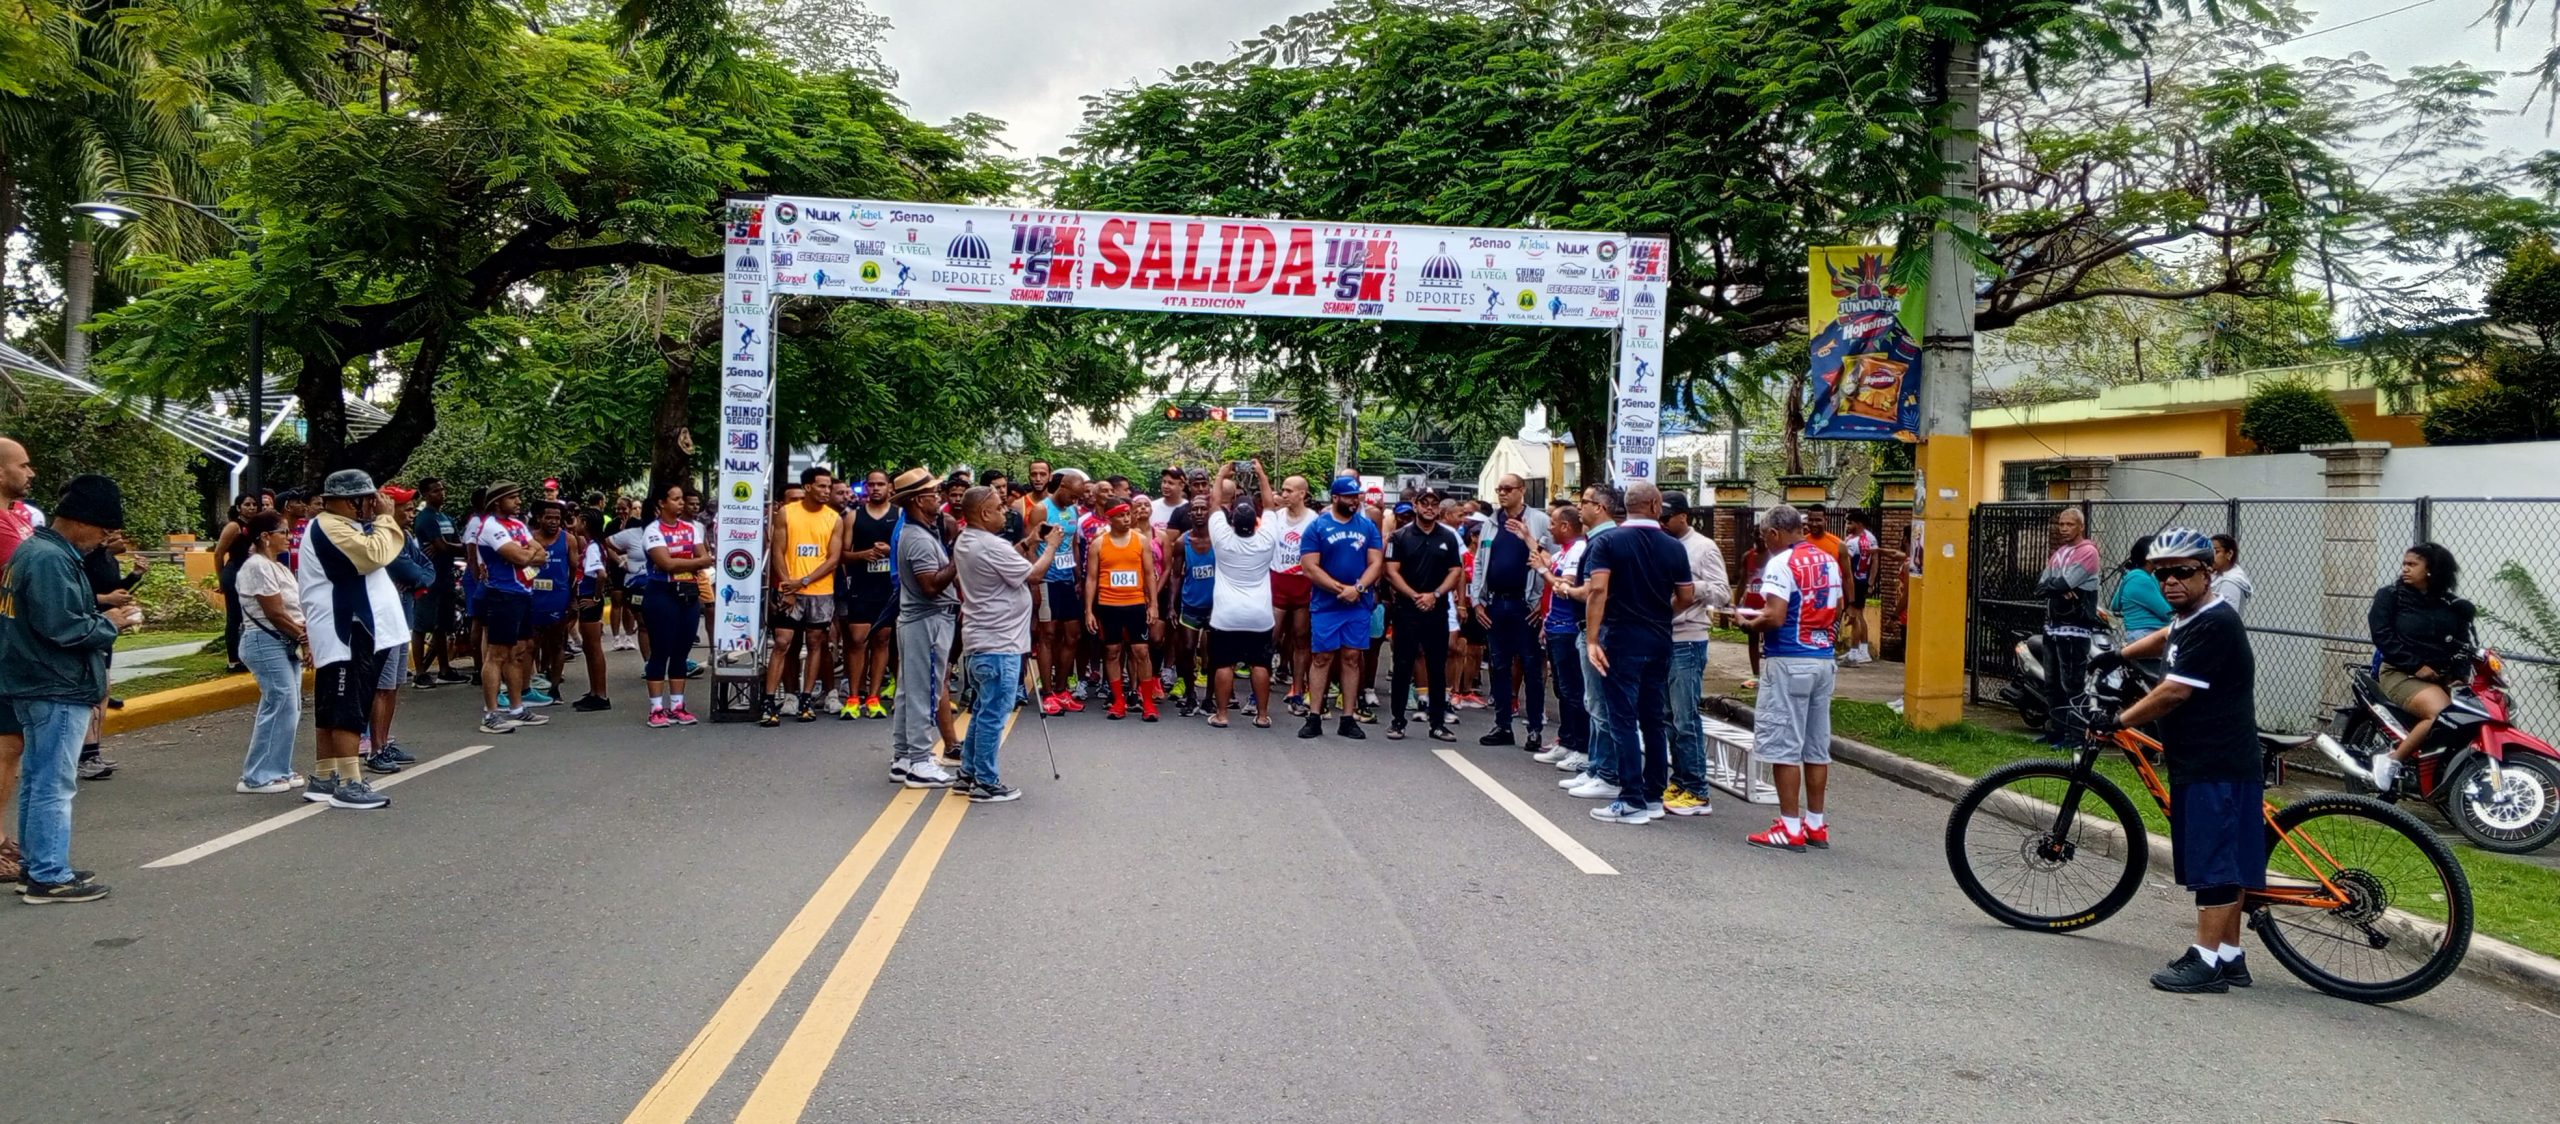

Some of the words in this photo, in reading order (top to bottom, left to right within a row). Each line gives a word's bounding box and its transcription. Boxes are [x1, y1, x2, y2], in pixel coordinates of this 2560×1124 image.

[894, 210, 934, 224] Genao
[1473, 237, 1511, 249] Genao
[893, 245, 908, 254] LA
[909, 246, 932, 255] VEGA
[1091, 218, 1317, 296] SALIDA
[728, 273, 768, 281] DEPORTES
[932, 270, 1005, 287] DEPORTES
[1471, 271, 1482, 280] LA
[1485, 271, 1507, 280] VEGA
[1010, 288, 1045, 302] SEMANA
[1046, 290, 1074, 303] SANTA
[1406, 291, 1476, 305] DEPORTES
[1162, 297, 1188, 307] 4TA
[1191, 296, 1246, 309] EDICIÓN
[1322, 301, 1356, 314] SEMANA
[1357, 303, 1384, 316] SANTA
[1838, 299, 1901, 315] JUNTADERA
[728, 305, 740, 315] LA
[741, 306, 765, 316] VEGA
[1627, 308, 1662, 316] DEPORTES
[1626, 340, 1638, 348] LA
[1639, 341, 1658, 349] VEGA
[730, 367, 764, 377] Genao
[729, 391, 762, 399] PREMIUM
[1626, 399, 1655, 409] Genao
[724, 405, 764, 418] CHINGO
[726, 416, 762, 426] REGIDOR
[1624, 421, 1653, 429] PREMIUM
[1618, 435, 1655, 447] CHINGO
[1620, 445, 1652, 455] REGIDOR
[724, 458, 760, 472] NUUK
[1327, 532, 1347, 544] BLUE
[1347, 531, 1366, 543] JAYS
[798, 546, 819, 557] 1271
[1112, 573, 1135, 586] 084
